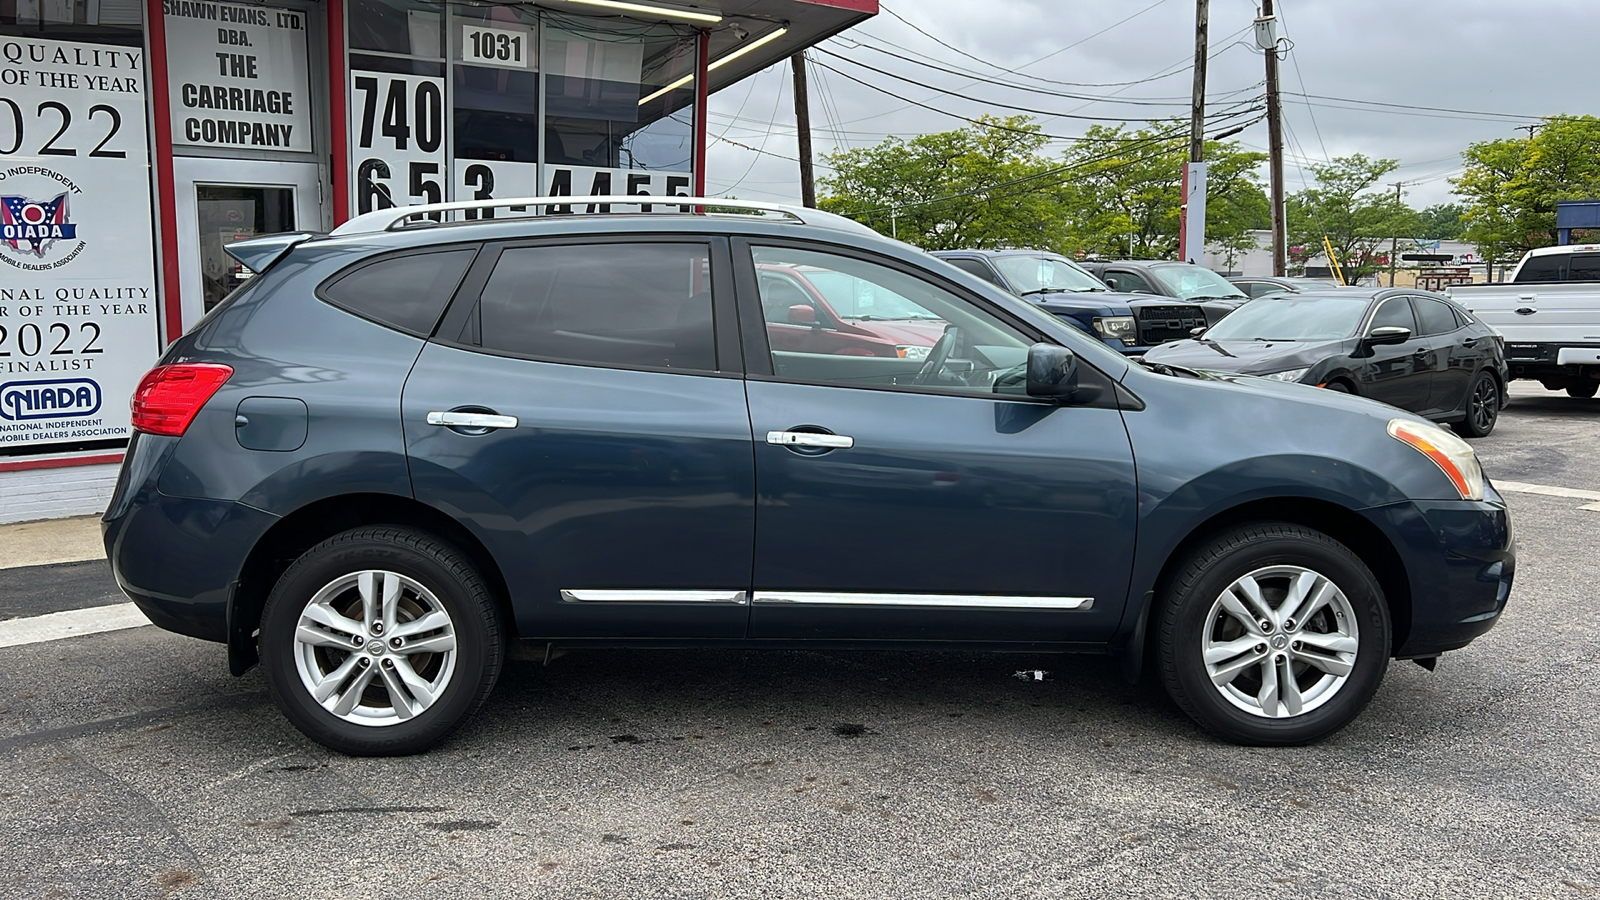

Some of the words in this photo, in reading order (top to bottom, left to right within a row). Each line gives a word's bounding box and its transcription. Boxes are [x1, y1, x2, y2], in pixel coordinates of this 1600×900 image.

[163, 0, 217, 20] SHAWN
[220, 6, 271, 27] EVANS.
[276, 12, 304, 30] LTD.
[218, 28, 253, 47] DBA.
[469, 31, 521, 62] 1031
[3, 42, 140, 70] QUALITY
[216, 53, 258, 79] THE
[1, 69, 30, 86] OF
[35, 71, 79, 89] THE
[84, 74, 139, 93] YEAR
[182, 83, 293, 115] CARRIAGE
[354, 76, 442, 153] 740
[185, 118, 293, 147] COMPANY
[7, 166, 82, 195] INDEPENDENT
[3, 225, 63, 238] OIADA
[0, 252, 21, 268] MOBILE
[22, 263, 52, 271] DEALERS
[53, 240, 87, 269] ASSOCIATION
[0, 288, 45, 301] NAL
[55, 287, 149, 303] QUALITY
[0, 306, 9, 317] R
[19, 305, 43, 317] OF
[53, 303, 91, 316] THE
[100, 303, 148, 315] YEAR
[4, 386, 92, 420] NIADA
[0, 422, 43, 432] NATIONAL
[45, 419, 103, 429] INDEPENDENT
[0, 433, 30, 443] MOBILE
[32, 430, 69, 440] DEALERS
[71, 427, 127, 438] ASSOCIATION
